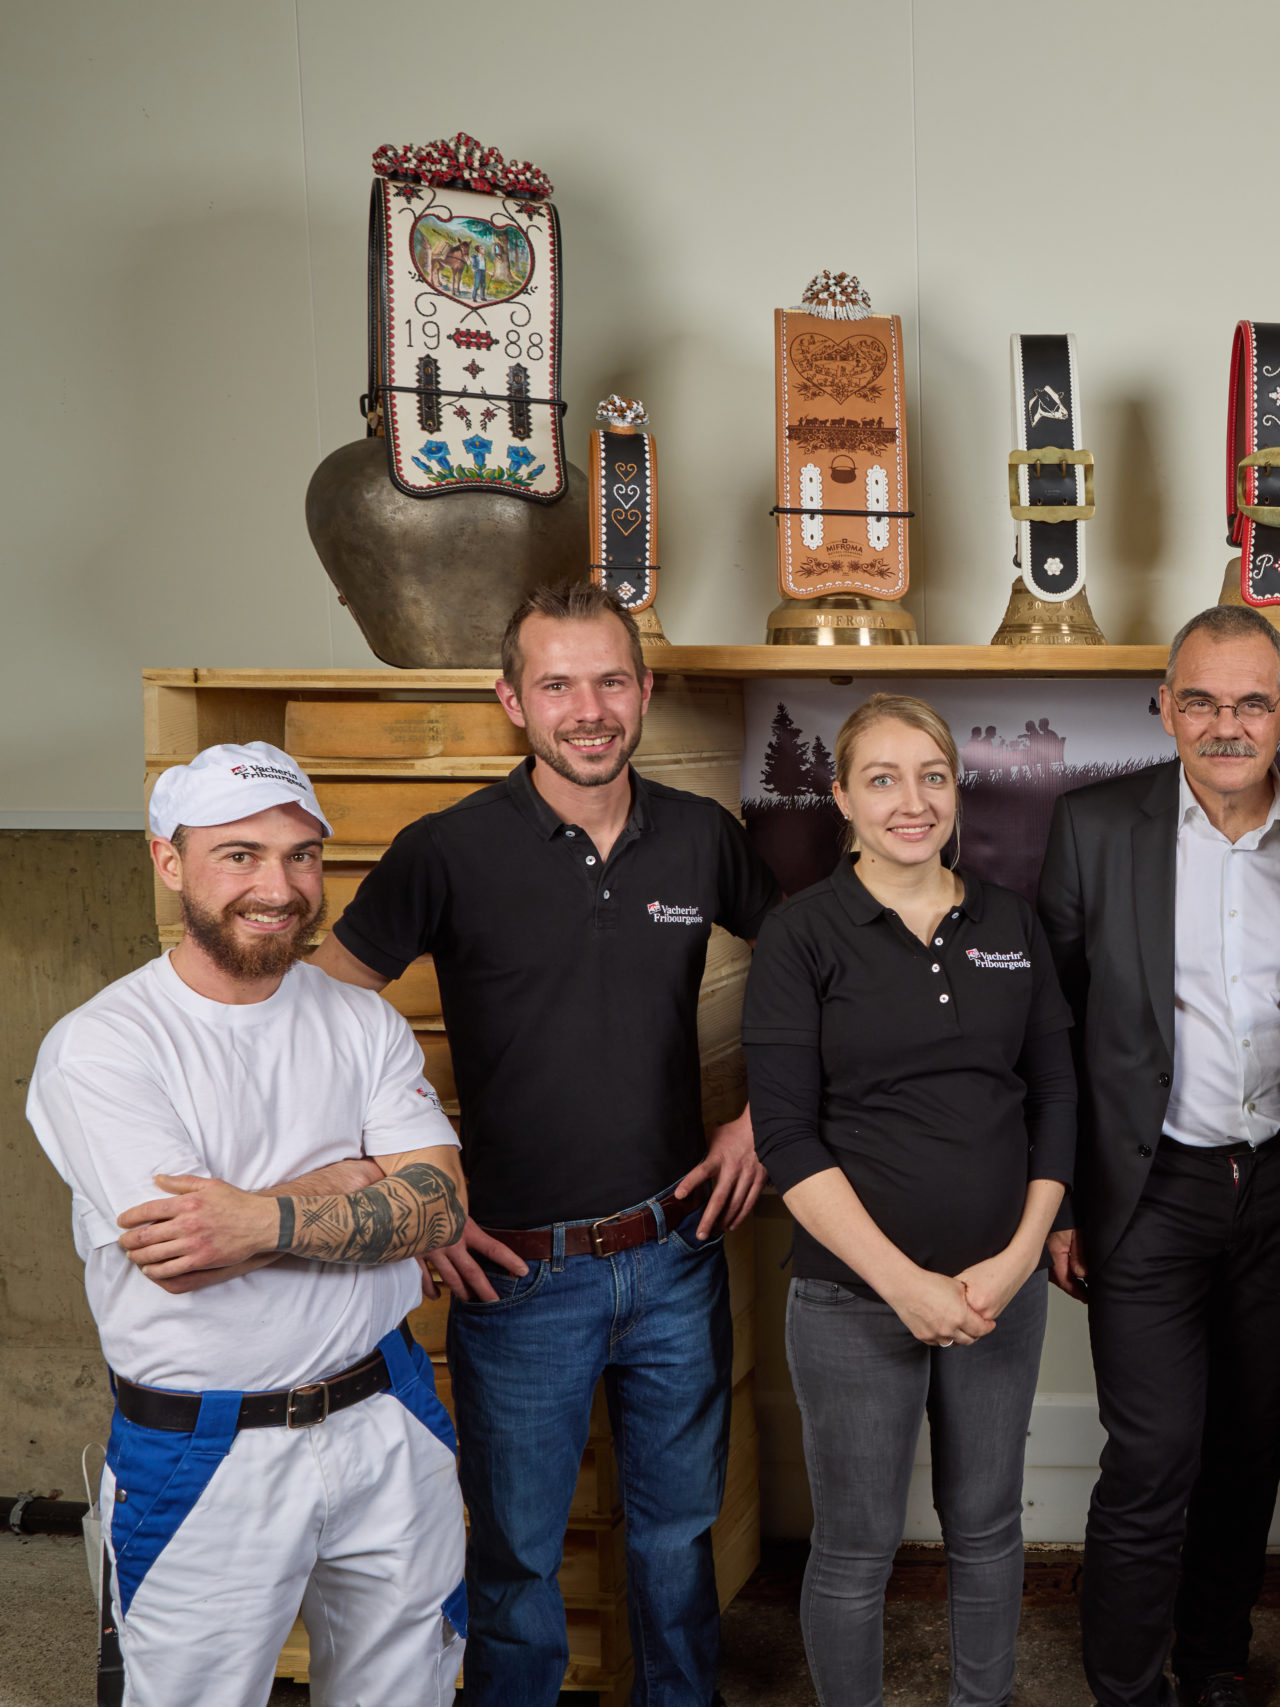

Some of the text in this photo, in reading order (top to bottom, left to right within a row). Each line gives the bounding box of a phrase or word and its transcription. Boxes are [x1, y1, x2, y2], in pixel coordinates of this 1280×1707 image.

[405, 318, 543, 361] 19 88
[826, 543, 863, 553] MIFROMA
[815, 614, 886, 628] MIFROMA
[250, 765, 298, 780] Vacherin
[654, 913, 703, 926] Fribourgeois
[974, 959, 1031, 970] Fribourgeois
